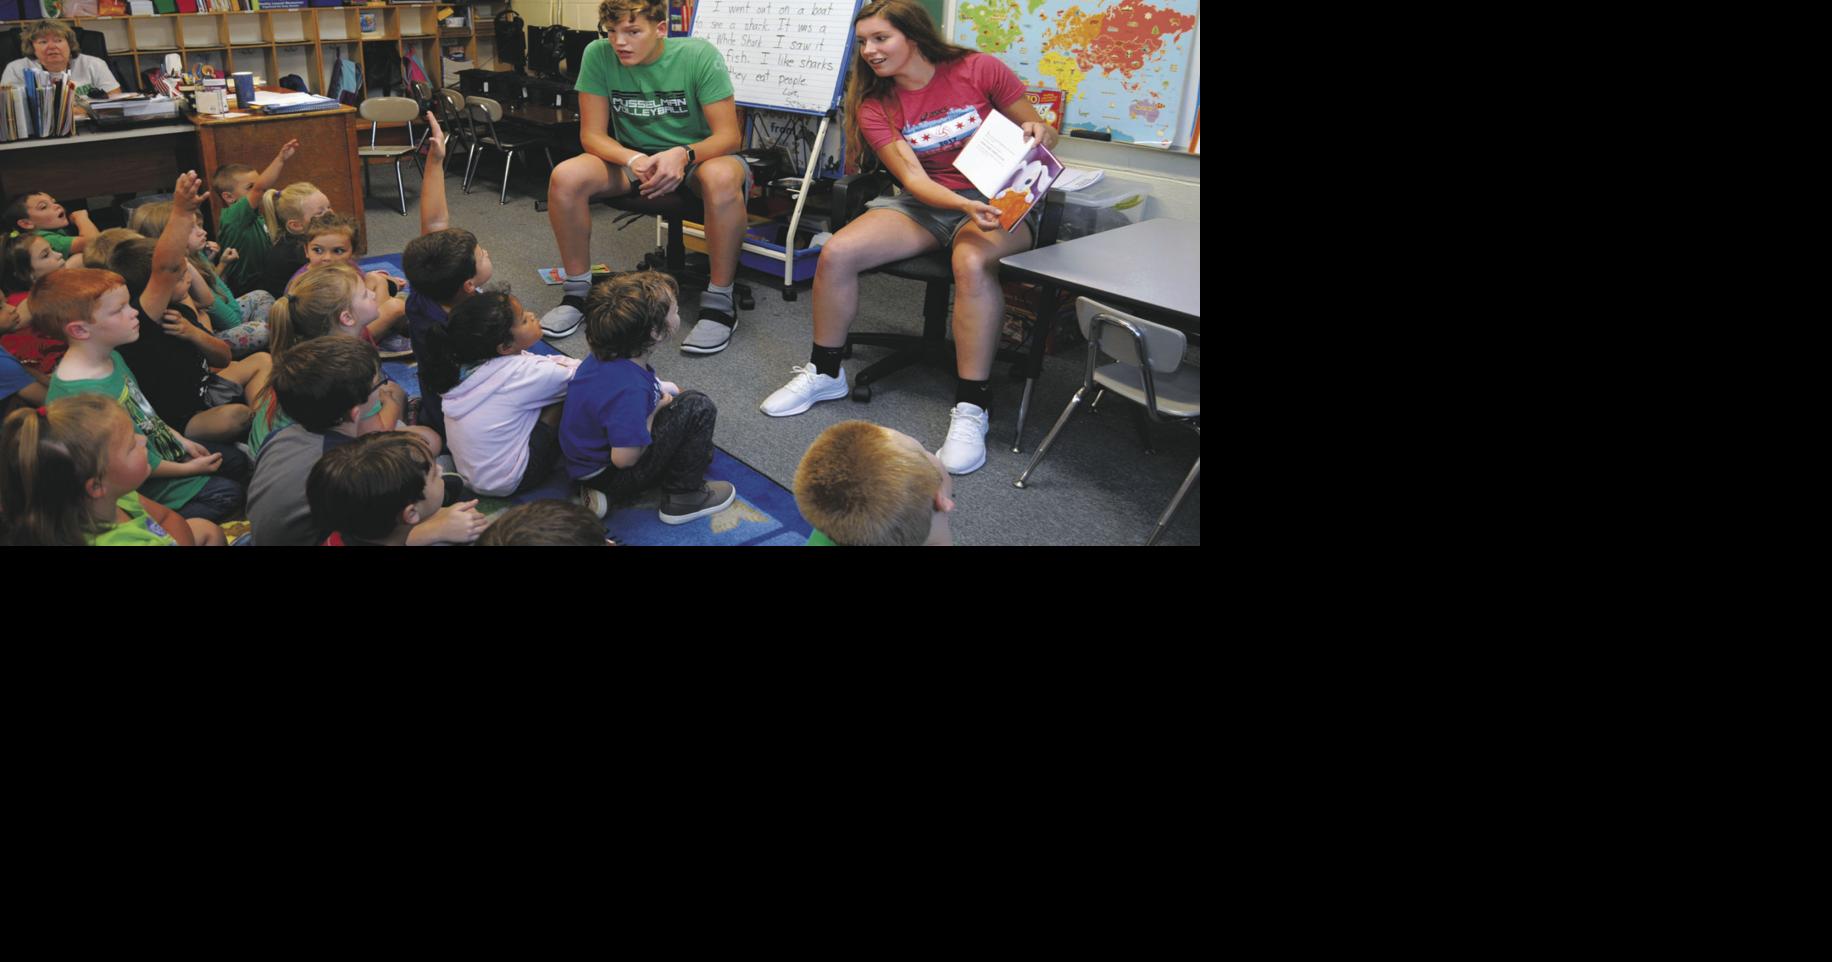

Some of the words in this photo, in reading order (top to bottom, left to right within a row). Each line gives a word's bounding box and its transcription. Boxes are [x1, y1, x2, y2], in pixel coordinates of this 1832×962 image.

[712, 0, 722, 12] I
[728, 1, 750, 15] went
[756, 2, 771, 14] out
[778, 6, 790, 15] on
[811, 2, 833, 16] boat
[711, 21, 723, 29] see
[729, 22, 736, 30] a
[777, 17, 791, 32] It
[797, 23, 812, 32] was
[819, 24, 827, 34] a
[772, 34, 785, 49] I
[790, 40, 811, 51] saw
[815, 38, 825, 51] it
[760, 51, 771, 65] I
[777, 53, 795, 67] like
[799, 55, 834, 71] sharks
[755, 69, 770, 82] eat
[612, 98, 687, 109] MUSSELMAN
[612, 105, 689, 117] VOLLEYBALL
